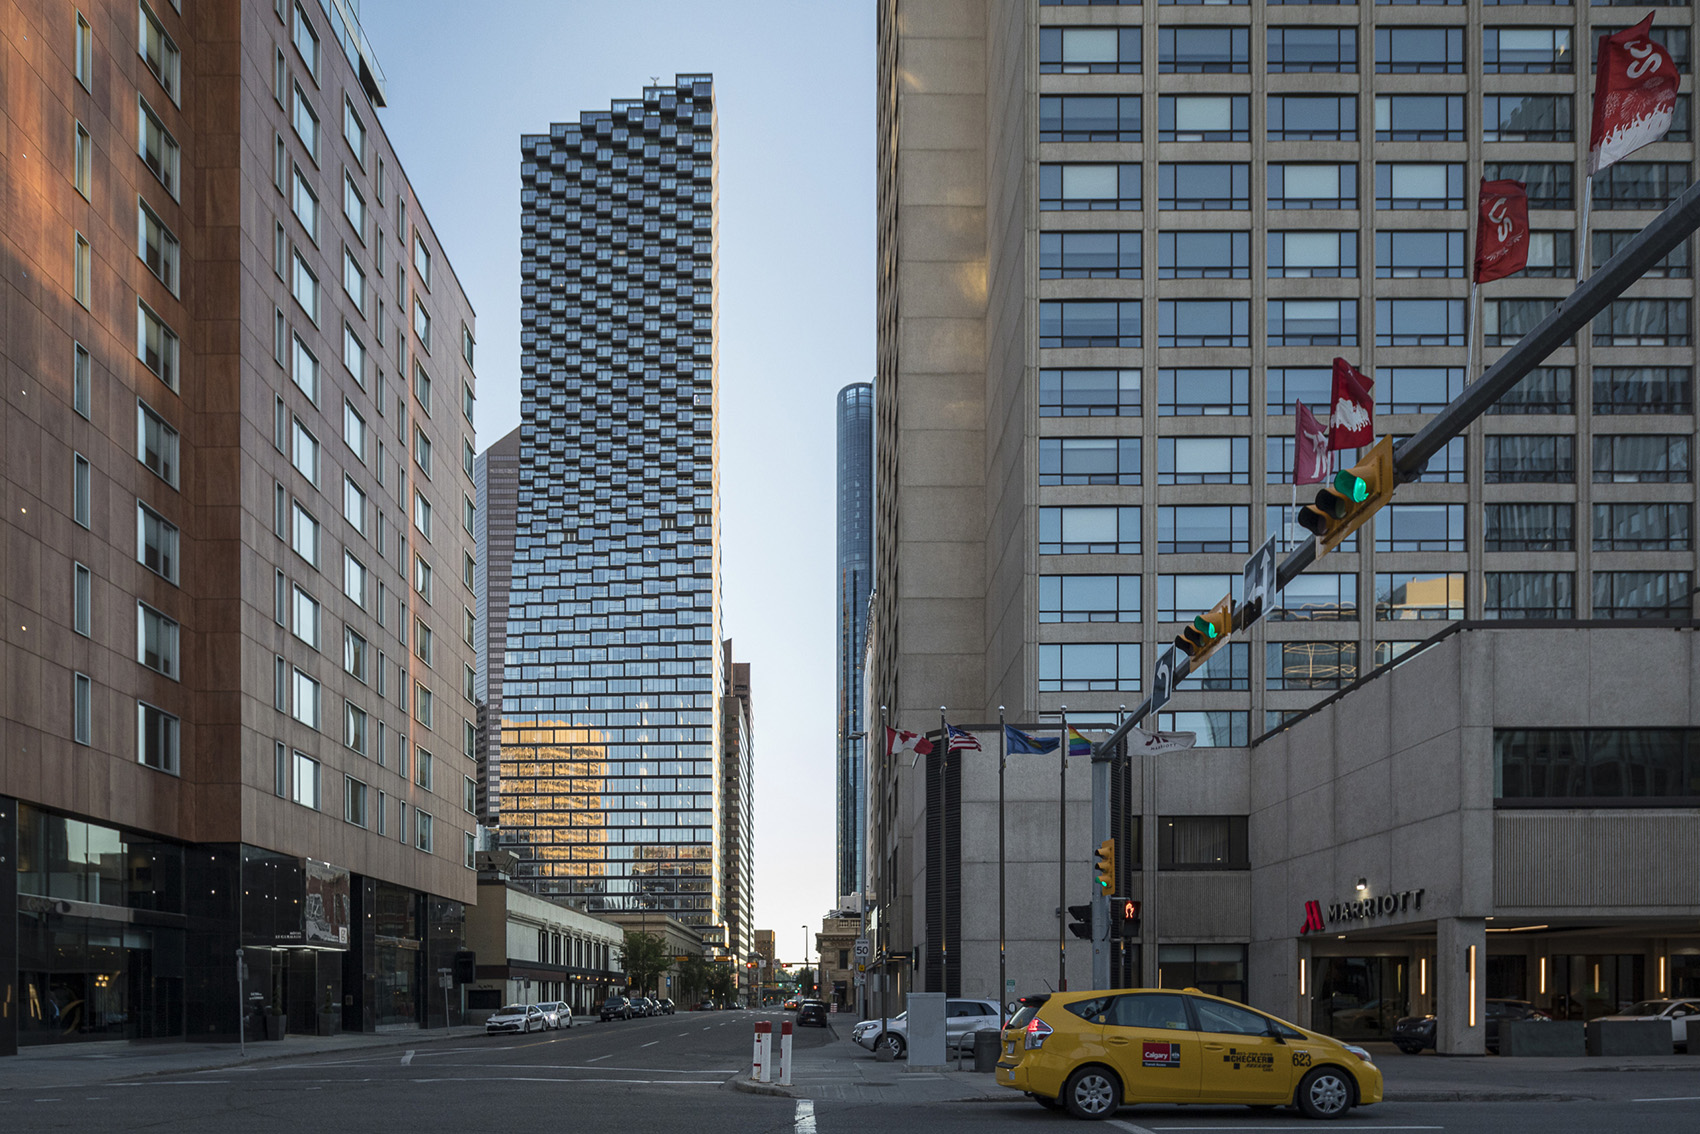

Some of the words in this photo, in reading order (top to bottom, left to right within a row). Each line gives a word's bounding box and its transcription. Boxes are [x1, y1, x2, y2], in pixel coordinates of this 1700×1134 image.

[1327, 888, 1425, 922] MARRIOTT
[856, 946, 869, 955] 50
[1144, 1051, 1168, 1060] Calgary
[1230, 1055, 1267, 1063] CHECKER
[1292, 1053, 1312, 1067] 623
